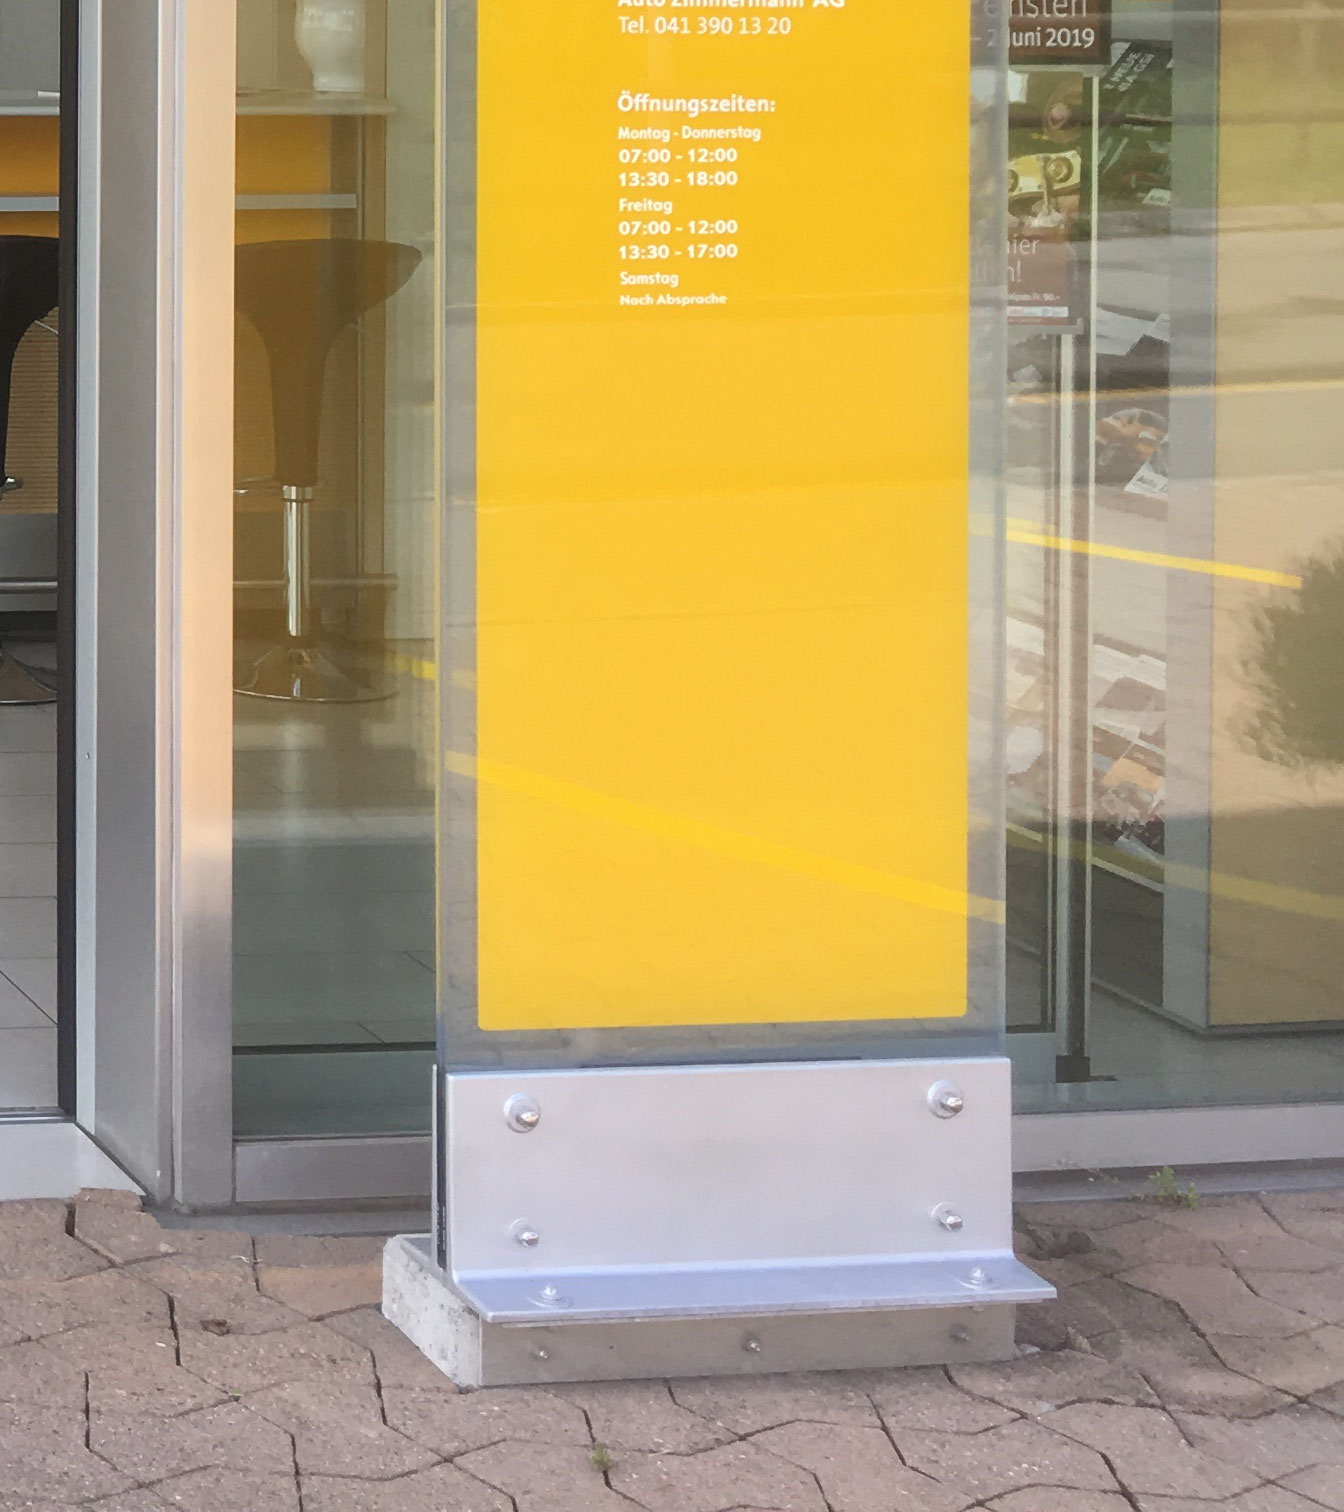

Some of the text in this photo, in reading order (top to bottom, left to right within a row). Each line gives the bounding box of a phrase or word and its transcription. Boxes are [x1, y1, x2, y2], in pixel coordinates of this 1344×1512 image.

[618, 15, 792, 35] Tel. 041 390 13 20
[1044, 27, 1096, 49] 2019
[616, 89, 777, 118] Öffnungszeiten:
[617, 126, 671, 143] Montag
[681, 125, 762, 143] Donnerstag
[618, 148, 672, 164] 07:00
[687, 147, 739, 163] 12:00
[618, 170, 670, 187] 13:30
[686, 170, 739, 187] 18:00
[618, 197, 674, 215] Freitag
[618, 220, 672, 236] 07:00
[687, 219, 739, 235] 12:00
[619, 244, 670, 260] 13:30
[687, 243, 739, 259] 17:00
[619, 271, 681, 289] Samstag
[619, 292, 728, 308] Nach Absprache
